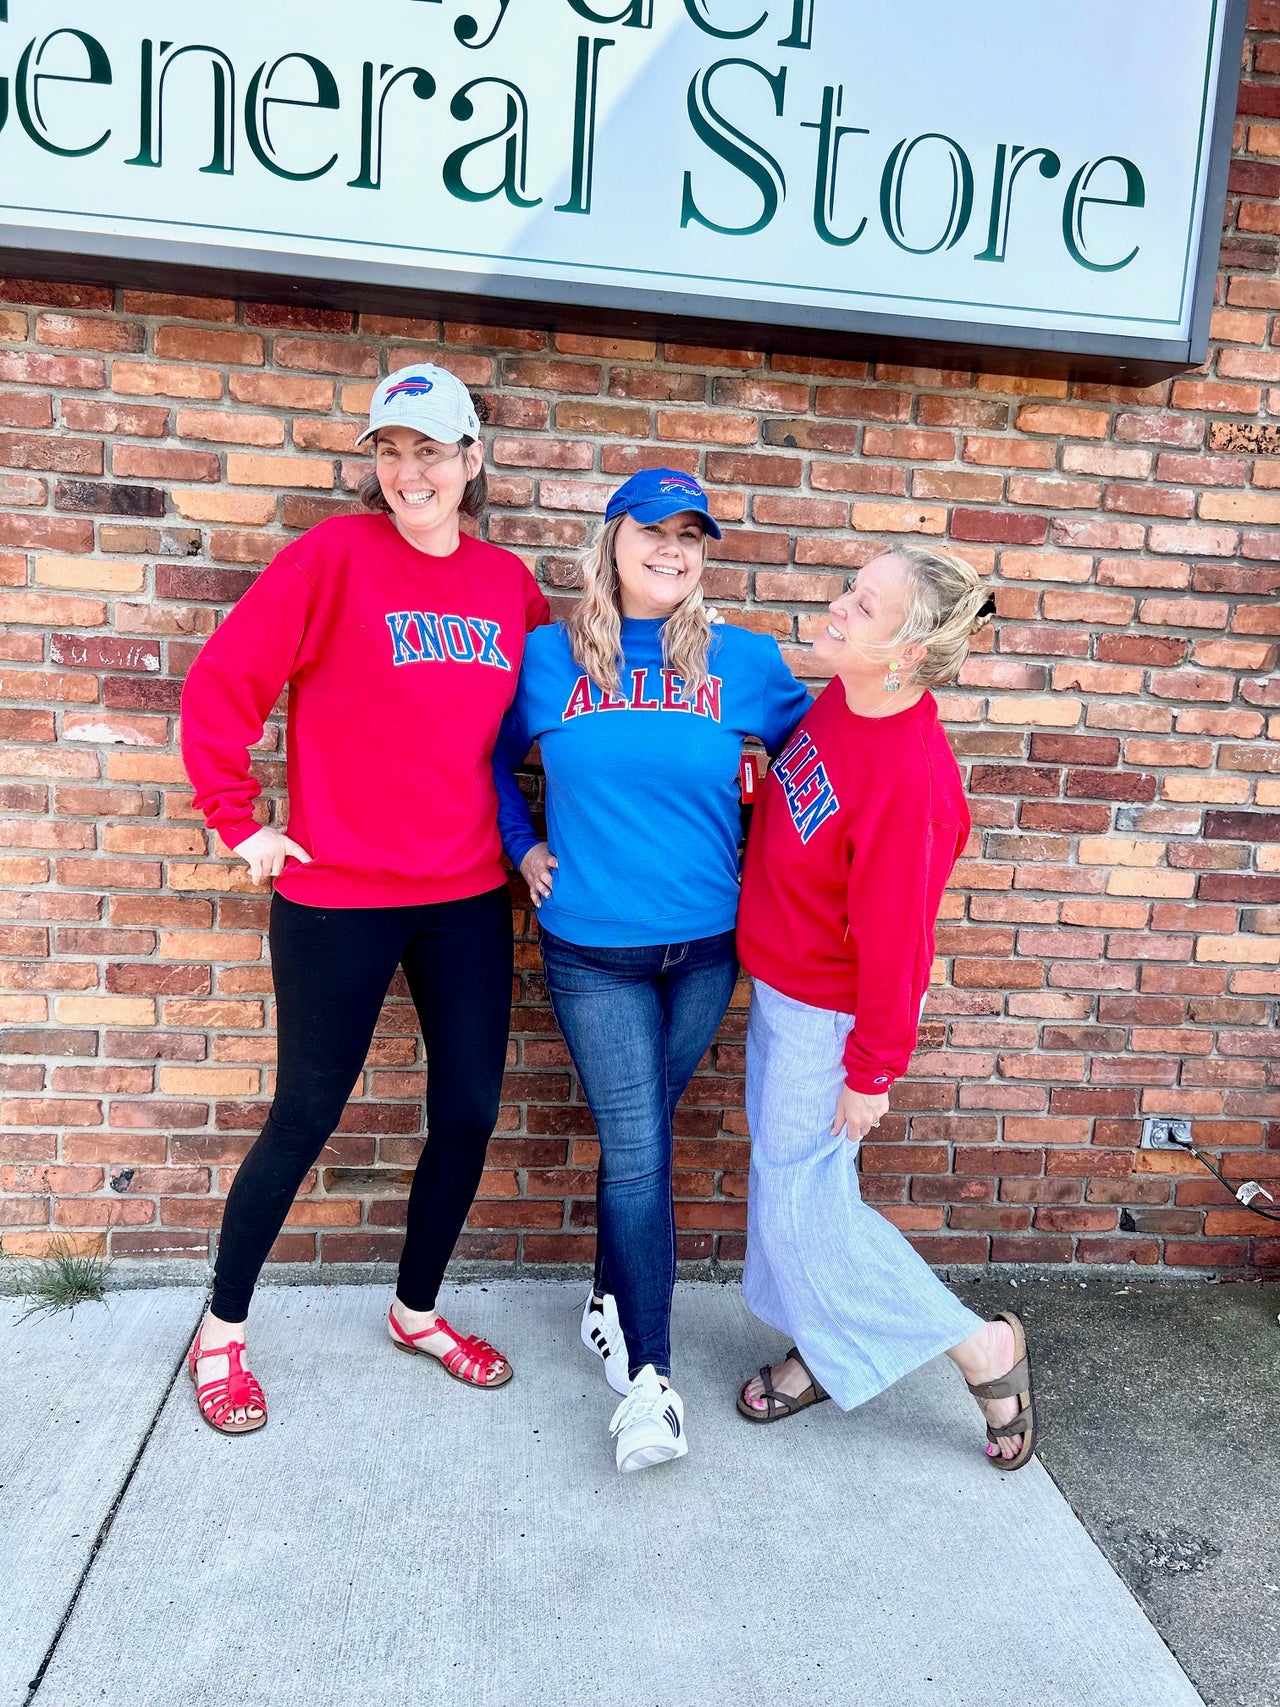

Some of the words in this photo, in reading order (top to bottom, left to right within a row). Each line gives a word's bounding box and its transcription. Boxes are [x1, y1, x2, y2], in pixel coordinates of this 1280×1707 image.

[0, 0, 615, 215] eneral
[679, 57, 1147, 273] Store
[385, 611, 512, 671] KNOX
